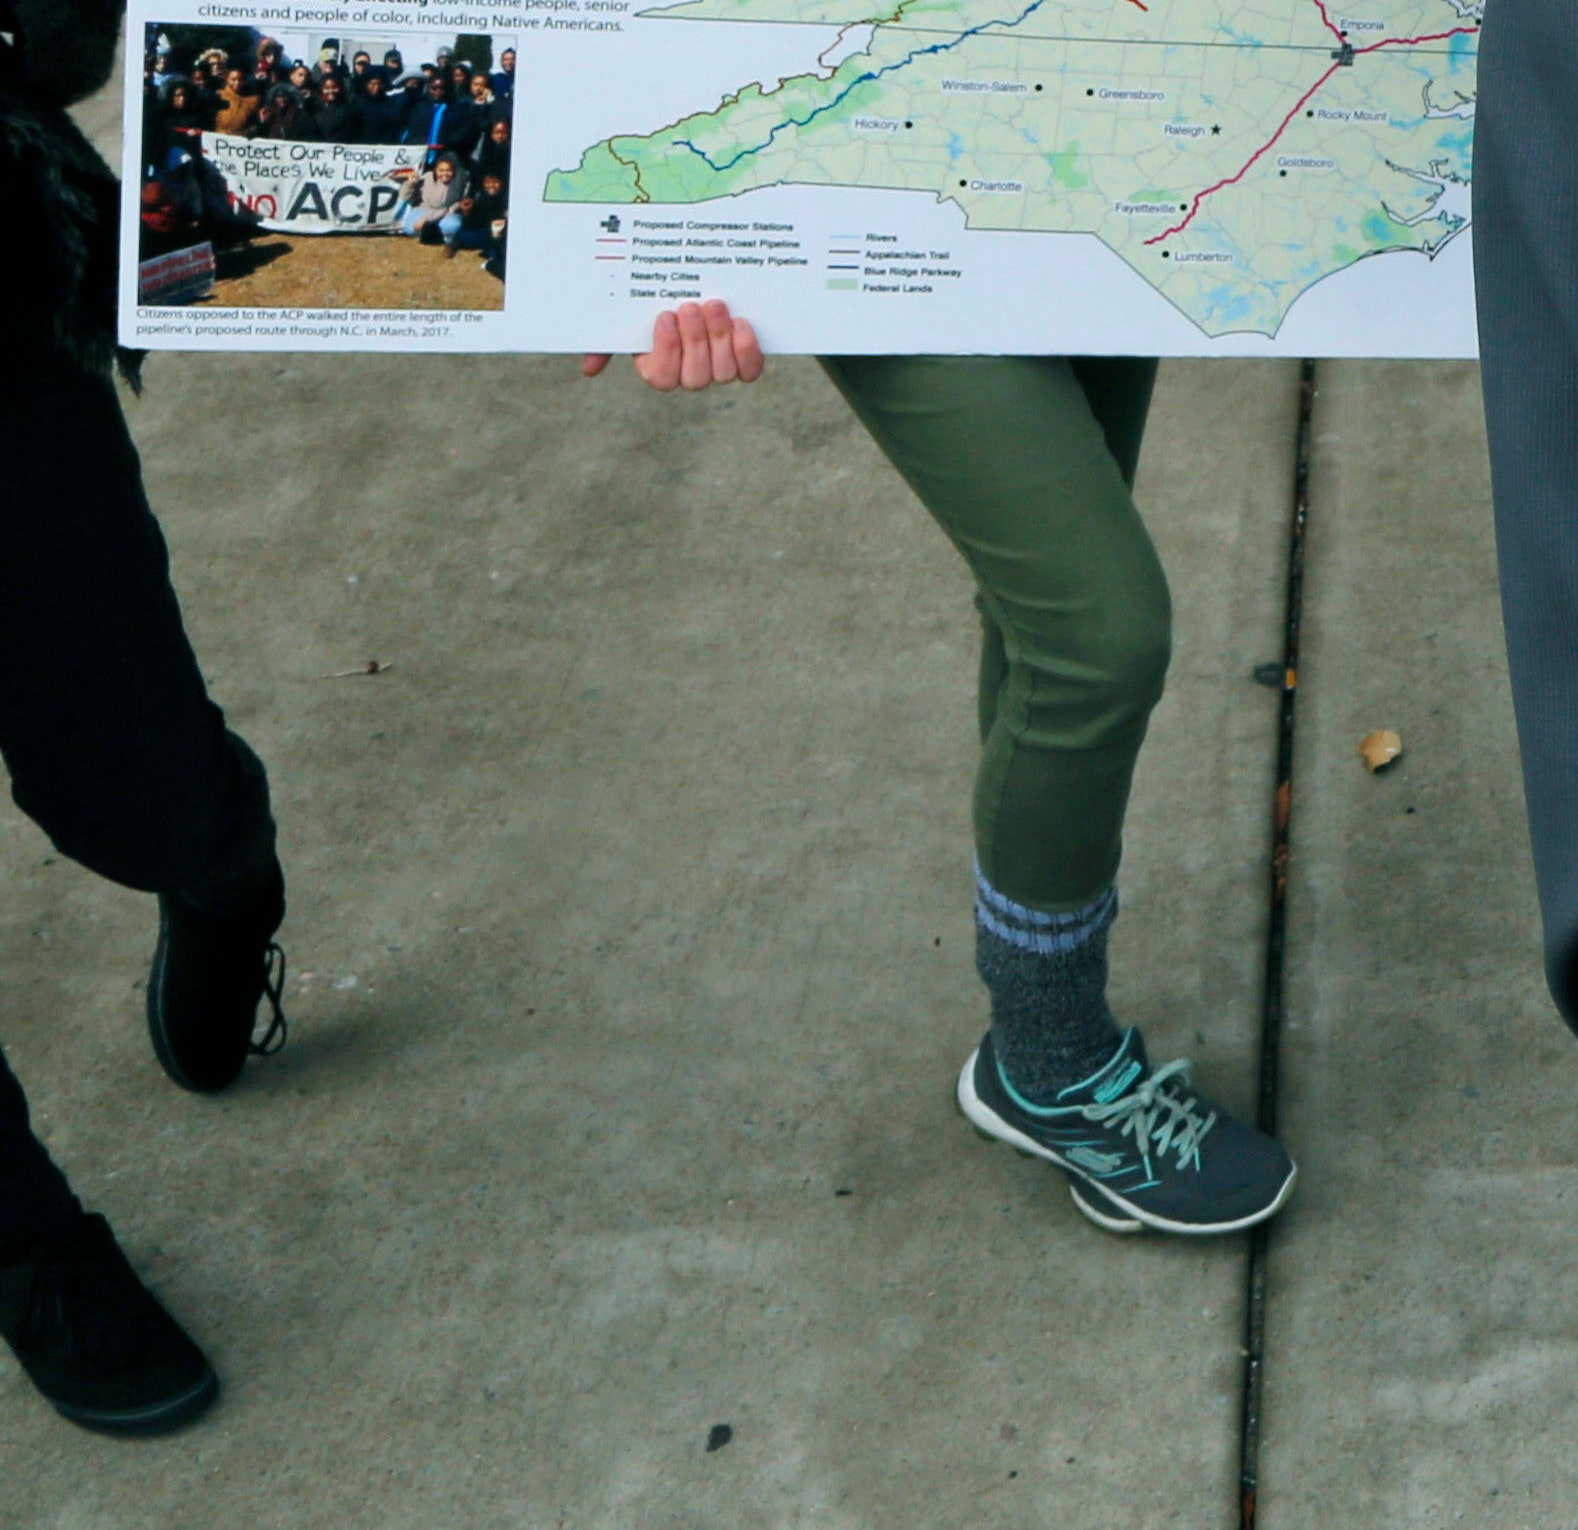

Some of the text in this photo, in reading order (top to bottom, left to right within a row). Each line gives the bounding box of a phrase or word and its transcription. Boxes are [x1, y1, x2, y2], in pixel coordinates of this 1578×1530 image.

[1340, 20, 1385, 32] Emporia
[941, 80, 1027, 94] Winston-Salem
[1098, 89, 1164, 101] Greensboro
[1317, 110, 1387, 122] Rocky Mount
[854, 118, 899, 132] Hickory
[1164, 124, 1205, 137] Raleigh
[215, 138, 280, 160] Protect
[290, 145, 325, 161] Our
[332, 146, 385, 165] People
[244, 161, 302, 179] Places
[308, 163, 336, 179] We
[343, 164, 382, 182] Live
[970, 179, 1022, 192] Charlotte
[286, 181, 399, 224] ACP
